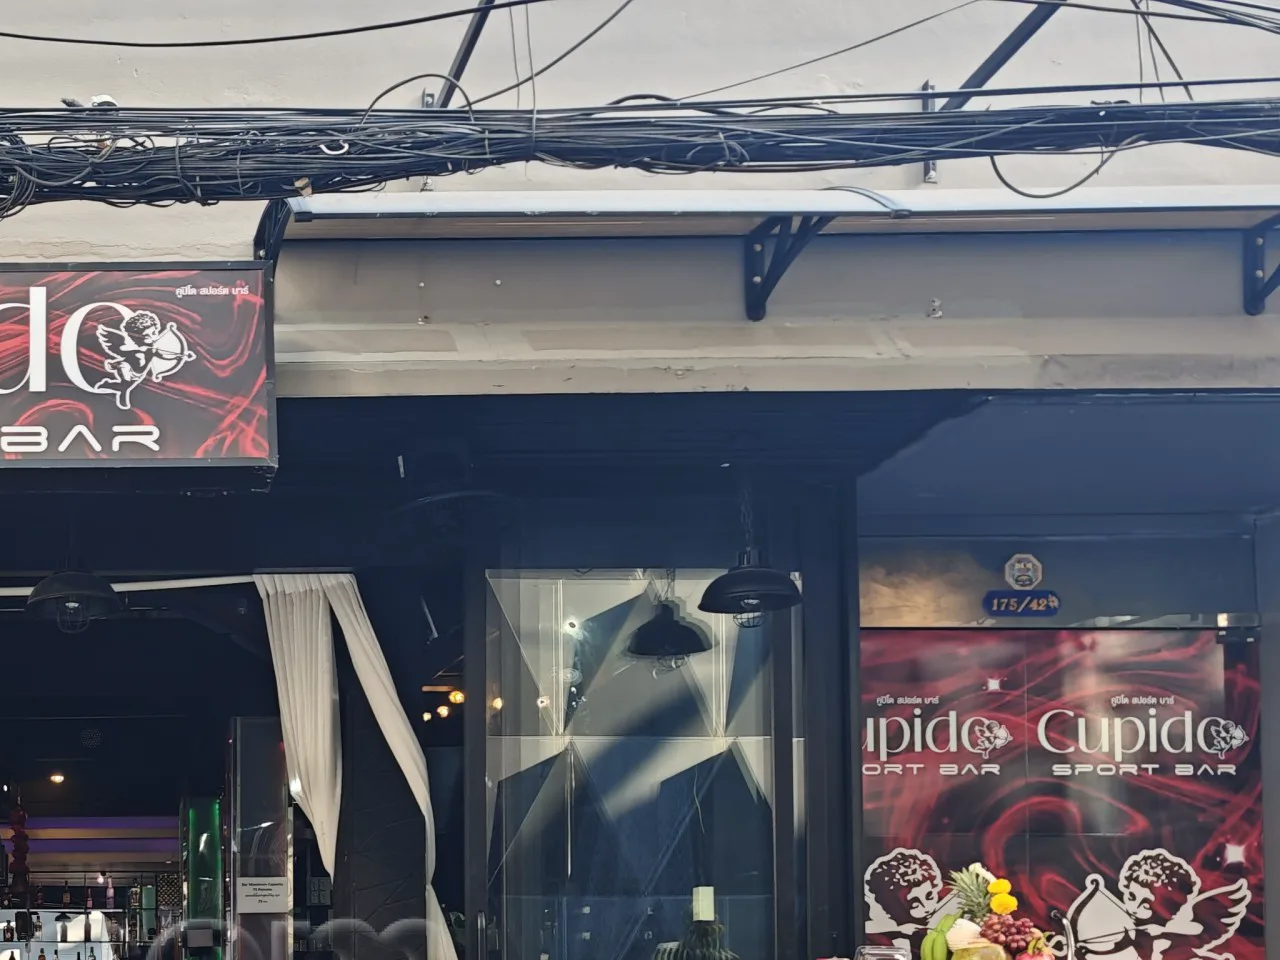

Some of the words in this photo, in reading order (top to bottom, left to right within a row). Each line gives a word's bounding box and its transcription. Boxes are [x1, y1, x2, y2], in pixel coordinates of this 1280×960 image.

[0, 425, 160, 453] BAR
[1036, 708, 1233, 763] Cupido
[939, 763, 1001, 776] BAR
[1051, 763, 1160, 776] SPORT
[1174, 763, 1237, 776] BAR
